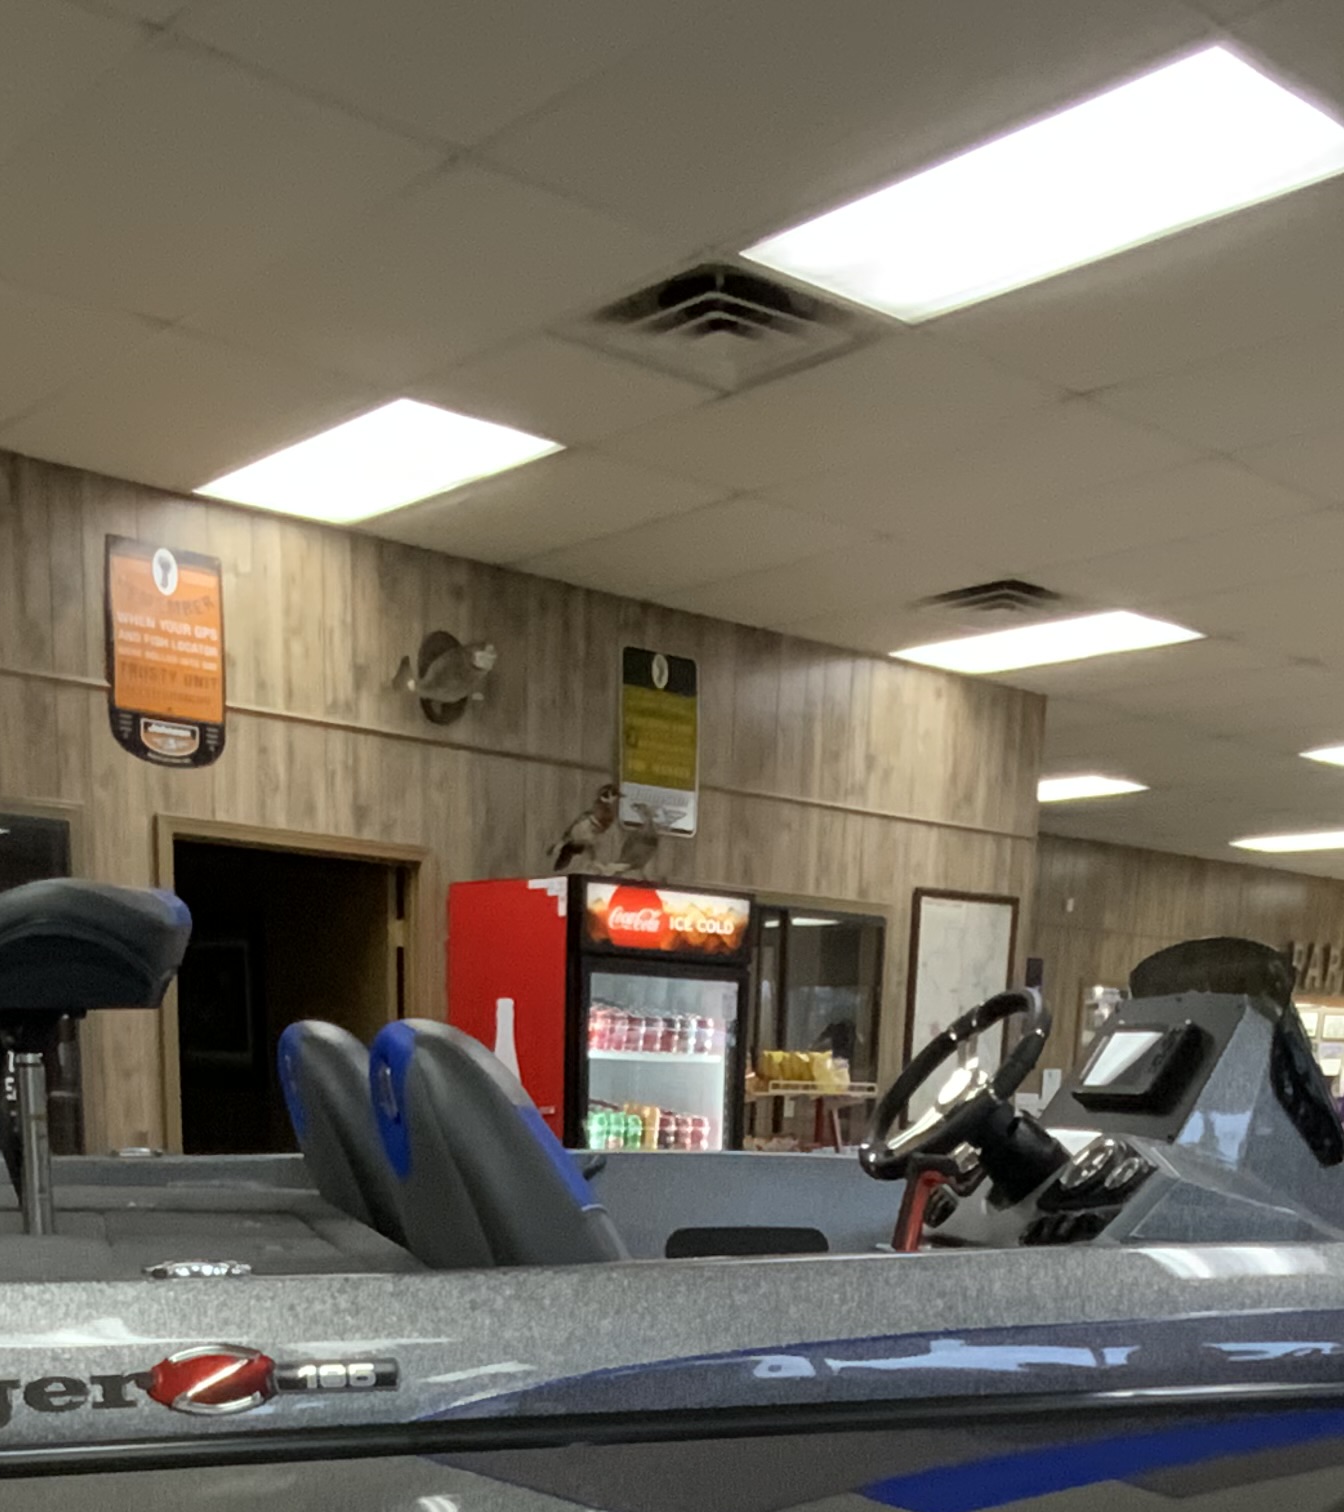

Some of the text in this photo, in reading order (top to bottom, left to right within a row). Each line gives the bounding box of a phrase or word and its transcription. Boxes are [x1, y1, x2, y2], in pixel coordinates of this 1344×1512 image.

[116, 611, 218, 642] WHEN YOUR GPS
[117, 628, 142, 644] AND
[143, 632, 170, 648] FISH
[119, 661, 178, 684] TRUSTY
[669, 915, 694, 932] ICE
[696, 919, 735, 935] COLD
